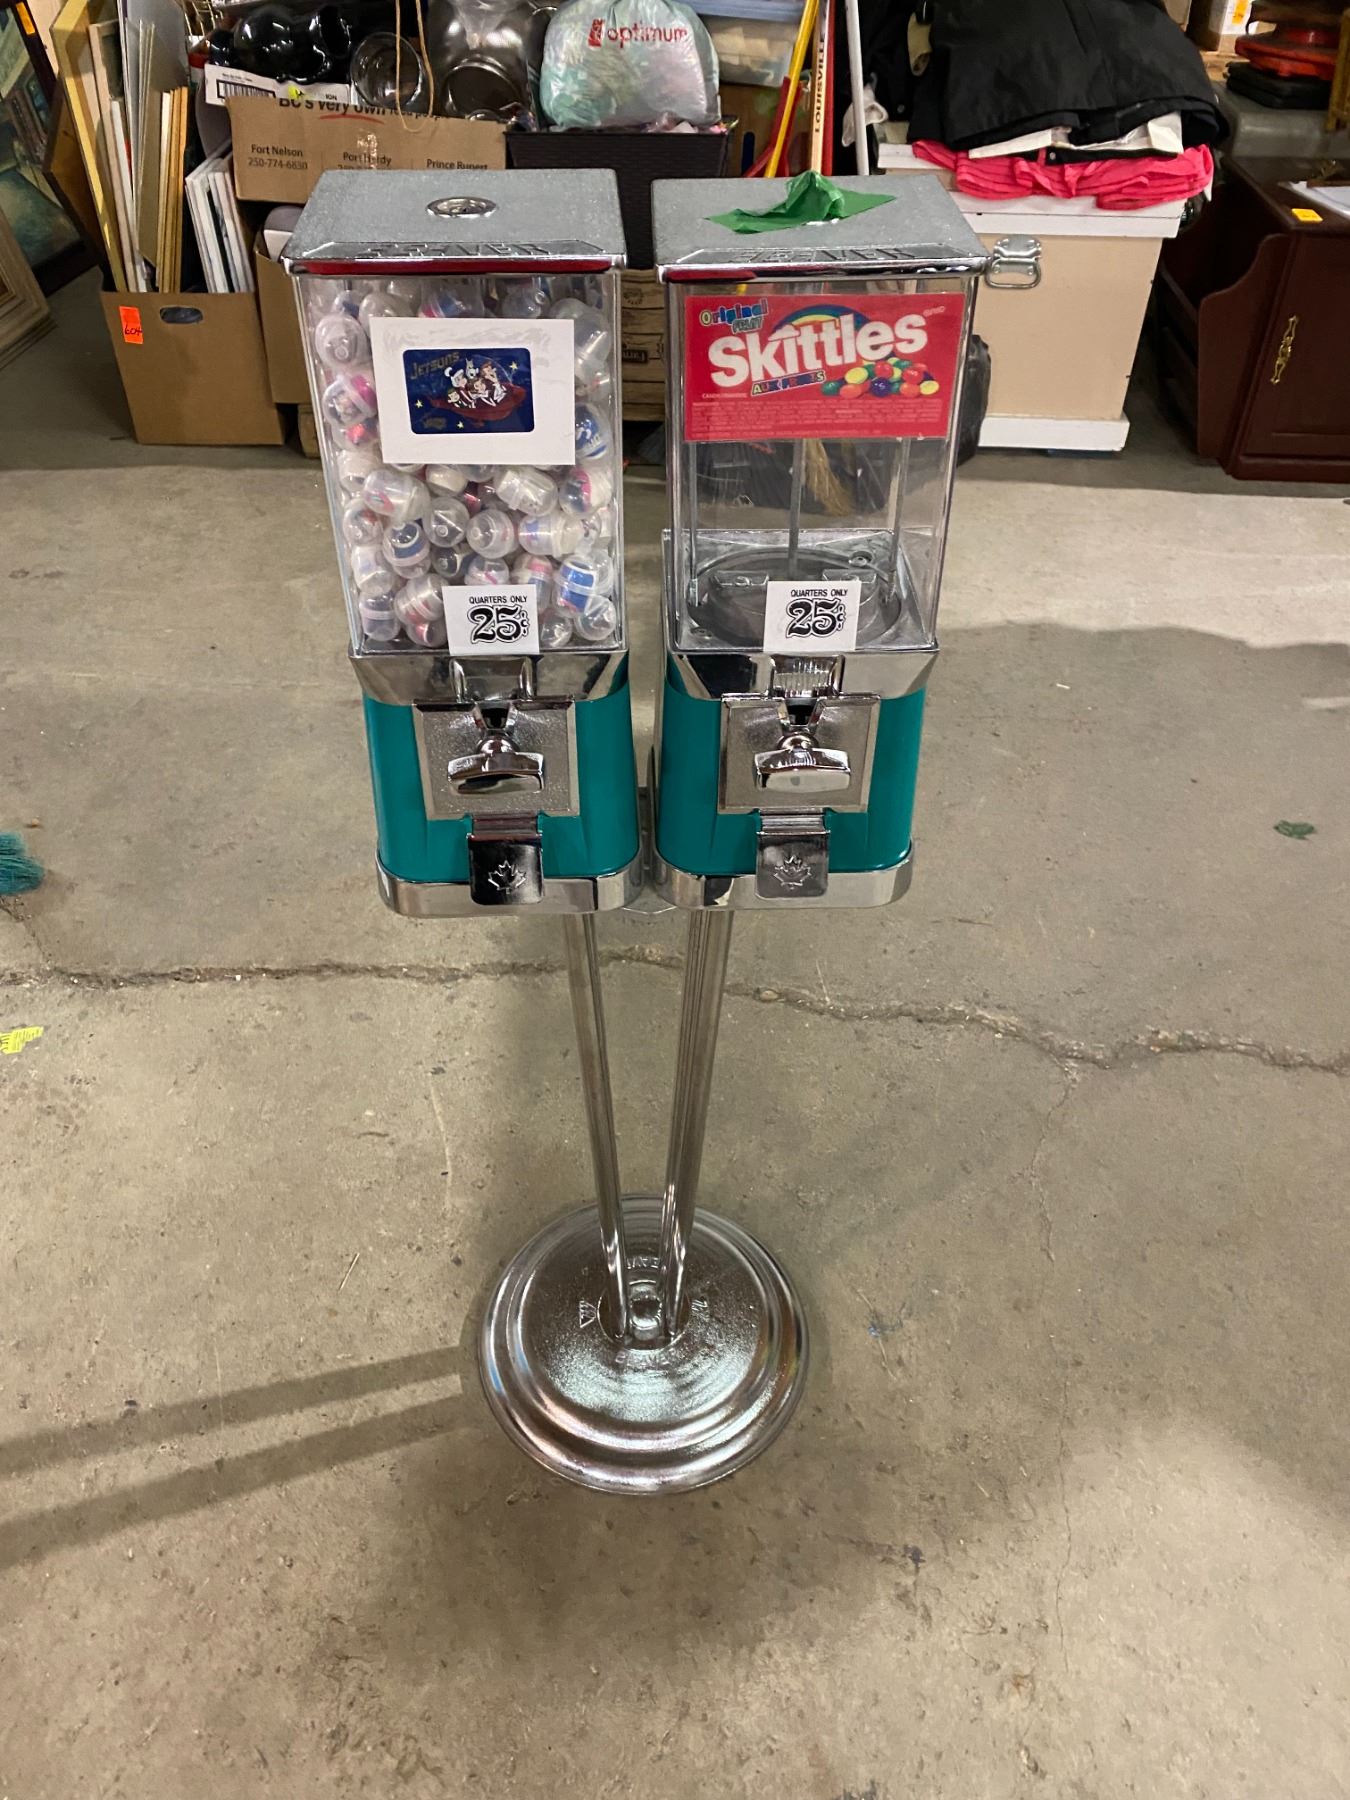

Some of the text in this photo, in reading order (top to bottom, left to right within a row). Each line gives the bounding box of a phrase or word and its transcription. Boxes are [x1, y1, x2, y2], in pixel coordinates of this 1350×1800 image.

[607, 22, 688, 48] optimum
[251, 144, 304, 157] Fort Nelson
[343, 151, 360, 163] Port
[363, 153, 392, 167] Hrdy
[426, 158, 456, 169] Prince
[708, 313, 929, 388] Skittles
[790, 588, 849, 598] QUARTERS ONLY
[468, 595, 528, 605] QUARTERS ONLY
